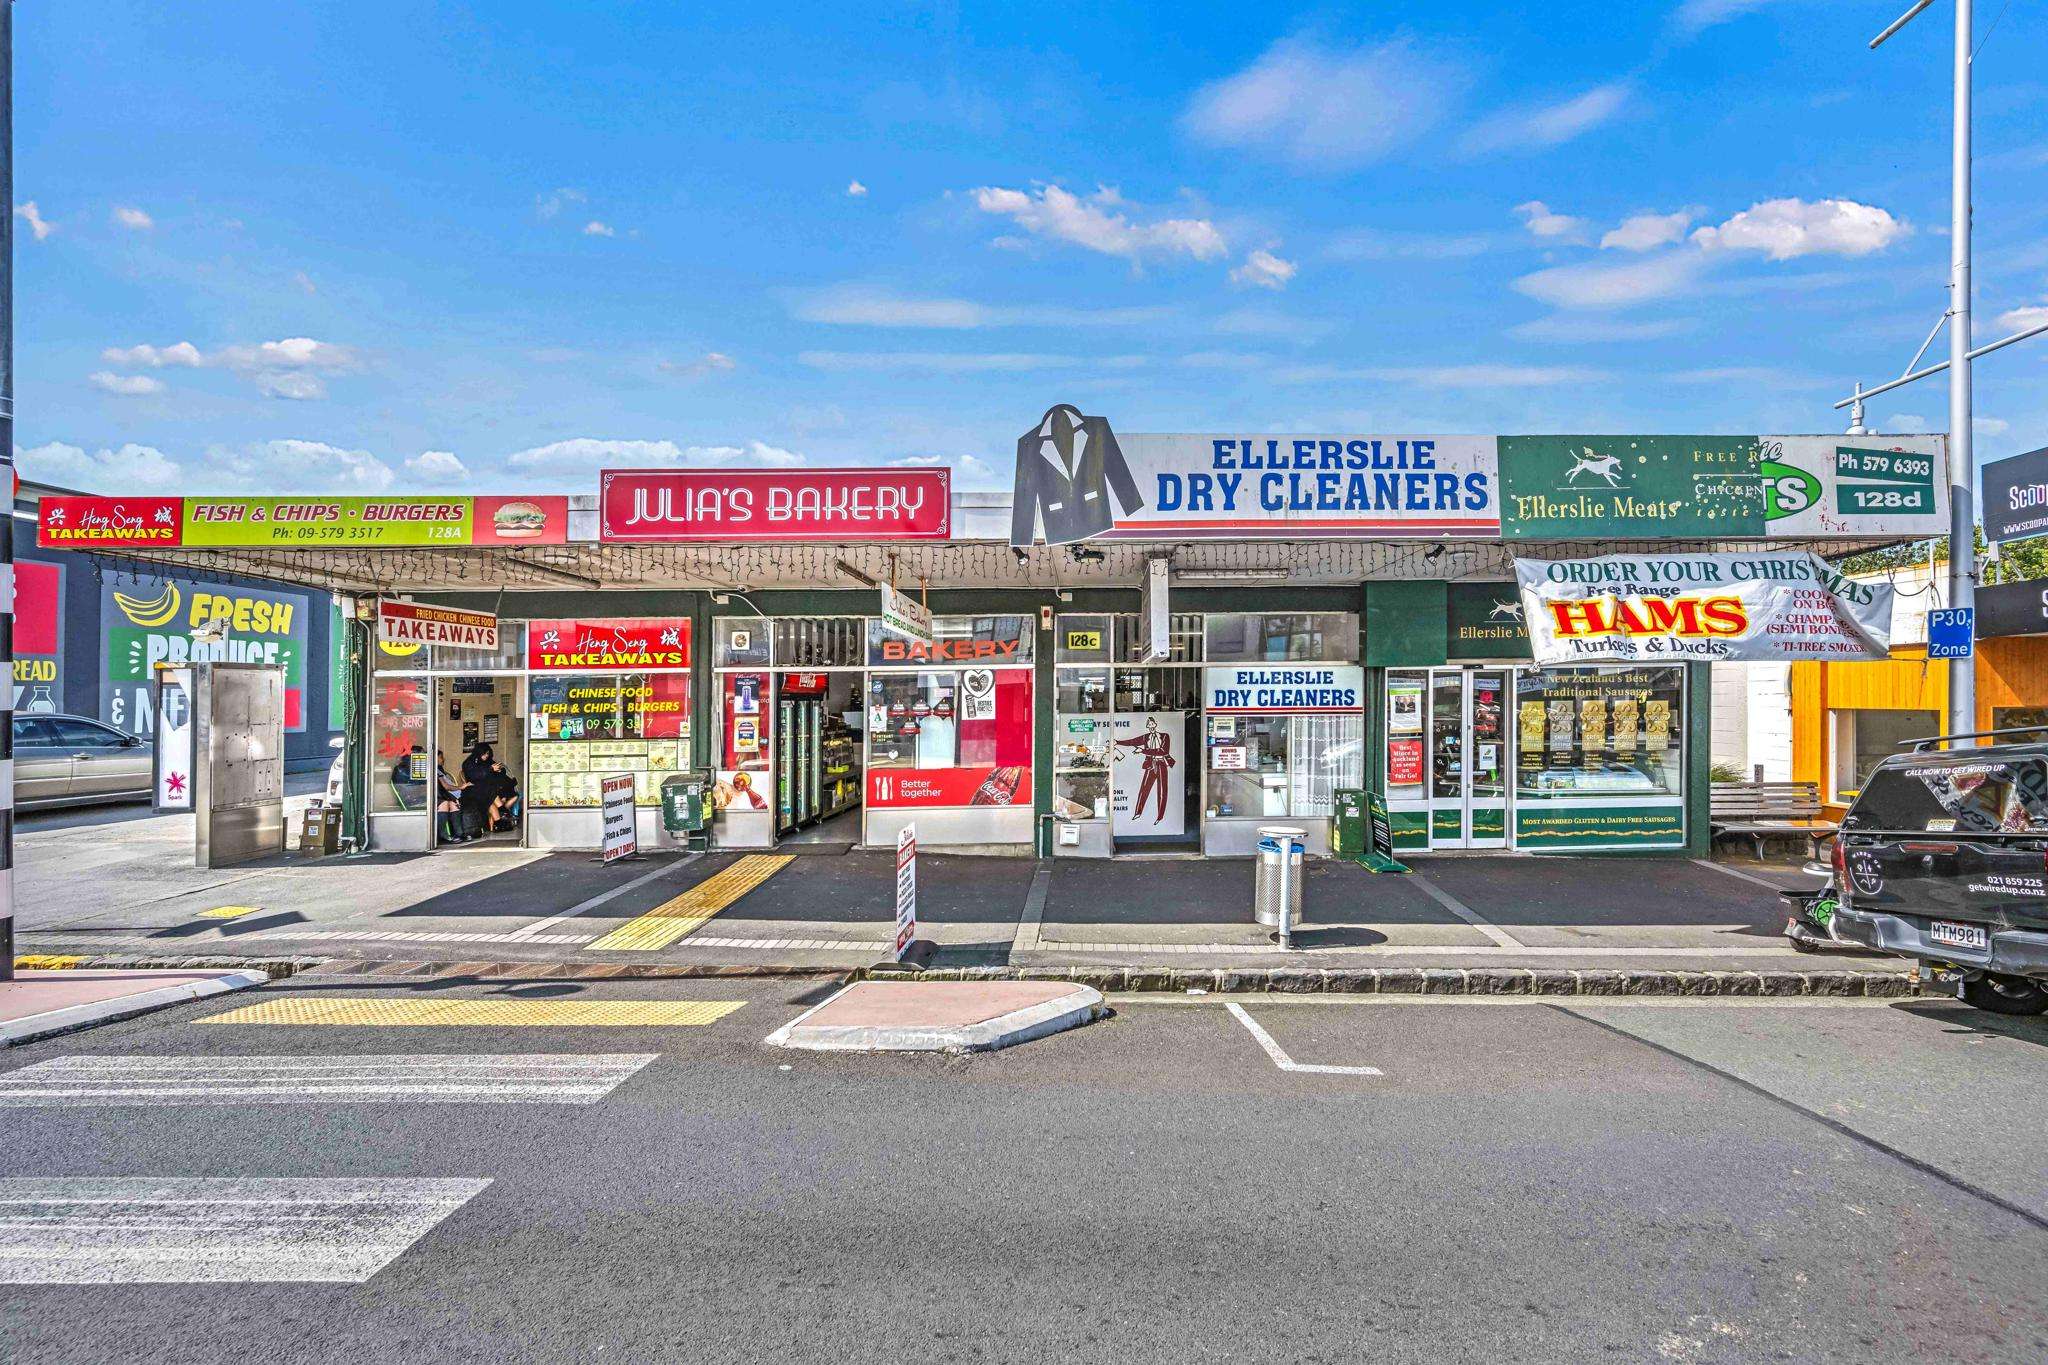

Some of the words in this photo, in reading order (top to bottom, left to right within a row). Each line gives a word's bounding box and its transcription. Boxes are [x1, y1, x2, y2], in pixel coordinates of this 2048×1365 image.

[1212, 440, 1436, 470] ELLERSLIE
[1839, 452, 1858, 469] Ph
[1863, 456, 1889, 471] 579
[1894, 459, 1929, 475] 6393
[1156, 473, 1242, 512] DRY
[1259, 472, 1488, 511] CLEANERS
[1853, 491, 1921, 507] 128d
[625, 487, 753, 525] JULIA'S
[765, 486, 924, 521] BAKERY
[1518, 495, 1605, 519] Ellerslie
[1614, 496, 1678, 518] Meats
[80, 507, 109, 531] Heng
[111, 505, 143, 530] Seng
[192, 505, 246, 522] FISH
[251, 507, 266, 521] &
[273, 504, 340, 522] CHIPS
[362, 504, 464, 521] BURGERS
[48, 528, 174, 539] TAKEAWAYS
[273, 527, 292, 539] Ph:
[297, 527, 344, 539] 09-579
[349, 527, 384, 538] 3517
[428, 527, 462, 539] 128A
[1547, 561, 1641, 583] ORDER
[1646, 561, 1722, 582] YOUR
[1731, 560, 1875, 605] CHRISMAS
[1587, 585, 1621, 597] Free
[1625, 584, 1681, 598] Range
[1793, 600, 1812, 609] ON
[189, 593, 294, 635] FRESH
[416, 609, 432, 619] FRIED
[434, 611, 457, 622] CHICKEN
[460, 614, 480, 624] CHINESE
[481, 617, 495, 627] FOOD
[1545, 595, 1749, 639] HAMS
[1932, 610, 1966, 627] P30
[384, 618, 495, 646] TAKEAWAYS
[1460, 626, 1512, 638] Ellerslie
[576, 630, 609, 656] Heng
[612, 627, 648, 655] Seng
[1569, 636, 1637, 655] Turkeys
[1645, 638, 1664, 653] &
[1669, 637, 1728, 655] Ducks
[884, 640, 1019, 660] BAKERY
[1931, 643, 1968, 656] Zone
[540, 652, 683, 665] TAKEAWAYS
[13, 660, 57, 681] READ
[1236, 671, 1334, 684] ELLERSLIE
[1625, 674, 1648, 683] Best
[569, 688, 616, 698] CHINESE
[620, 688, 653, 697] FOOD
[1214, 689, 1251, 707] DRY
[1257, 689, 1355, 707] CLEANERS
[1542, 687, 1602, 696] Traditional
[542, 703, 567, 714] FISH
[570, 703, 579, 713] &
[584, 702, 617, 713] CHIPS
[627, 701, 680, 712] BURGERS
[536, 719, 543, 728] A
[586, 719, 600, 730] 09
[874, 713, 882, 722] A
[1905, 769, 1922, 777] CALL
[1923, 768, 1940, 776] NOW
[1941, 767, 1950, 775] TO
[1952, 766, 1968, 774] GET
[1968, 765, 1992, 773] WIRED
[1993, 764, 2005, 772] UP
[603, 781, 618, 793] OPEN
[901, 780, 931, 788] Better
[901, 789, 942, 799] together
[606, 847, 619, 859] OPEN
[623, 842, 635, 854] DAYS
[1987, 876, 2004, 884] 021
[2005, 877, 2022, 886] 859
[2024, 879, 2043, 887] 225
[1968, 884, 2046, 896] getwiredup.co.nz
[1932, 923, 1981, 944] MTM901
